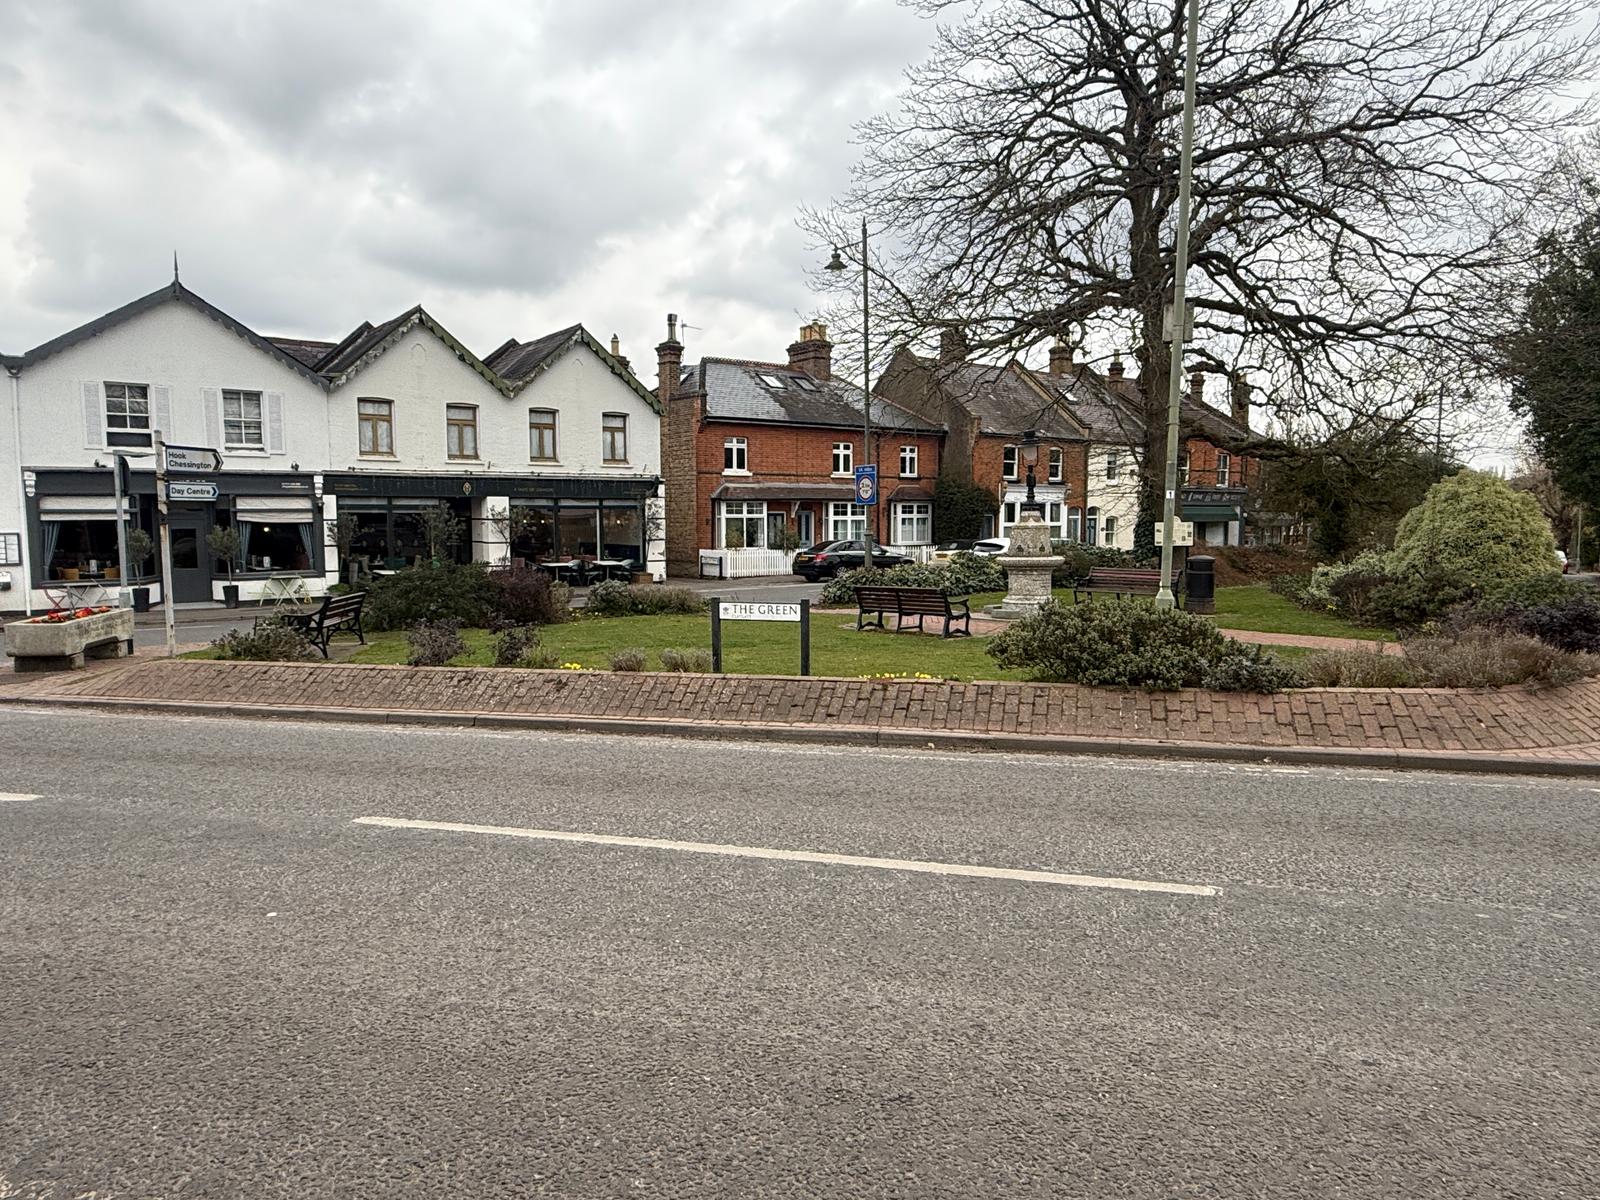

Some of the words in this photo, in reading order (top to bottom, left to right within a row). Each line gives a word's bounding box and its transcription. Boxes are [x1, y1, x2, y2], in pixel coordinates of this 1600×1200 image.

[168, 451, 187, 459] Hook
[169, 460, 212, 469] Chessington
[171, 487, 185, 495] Day
[732, 604, 754, 614] THE
[758, 604, 797, 615] GREEN
